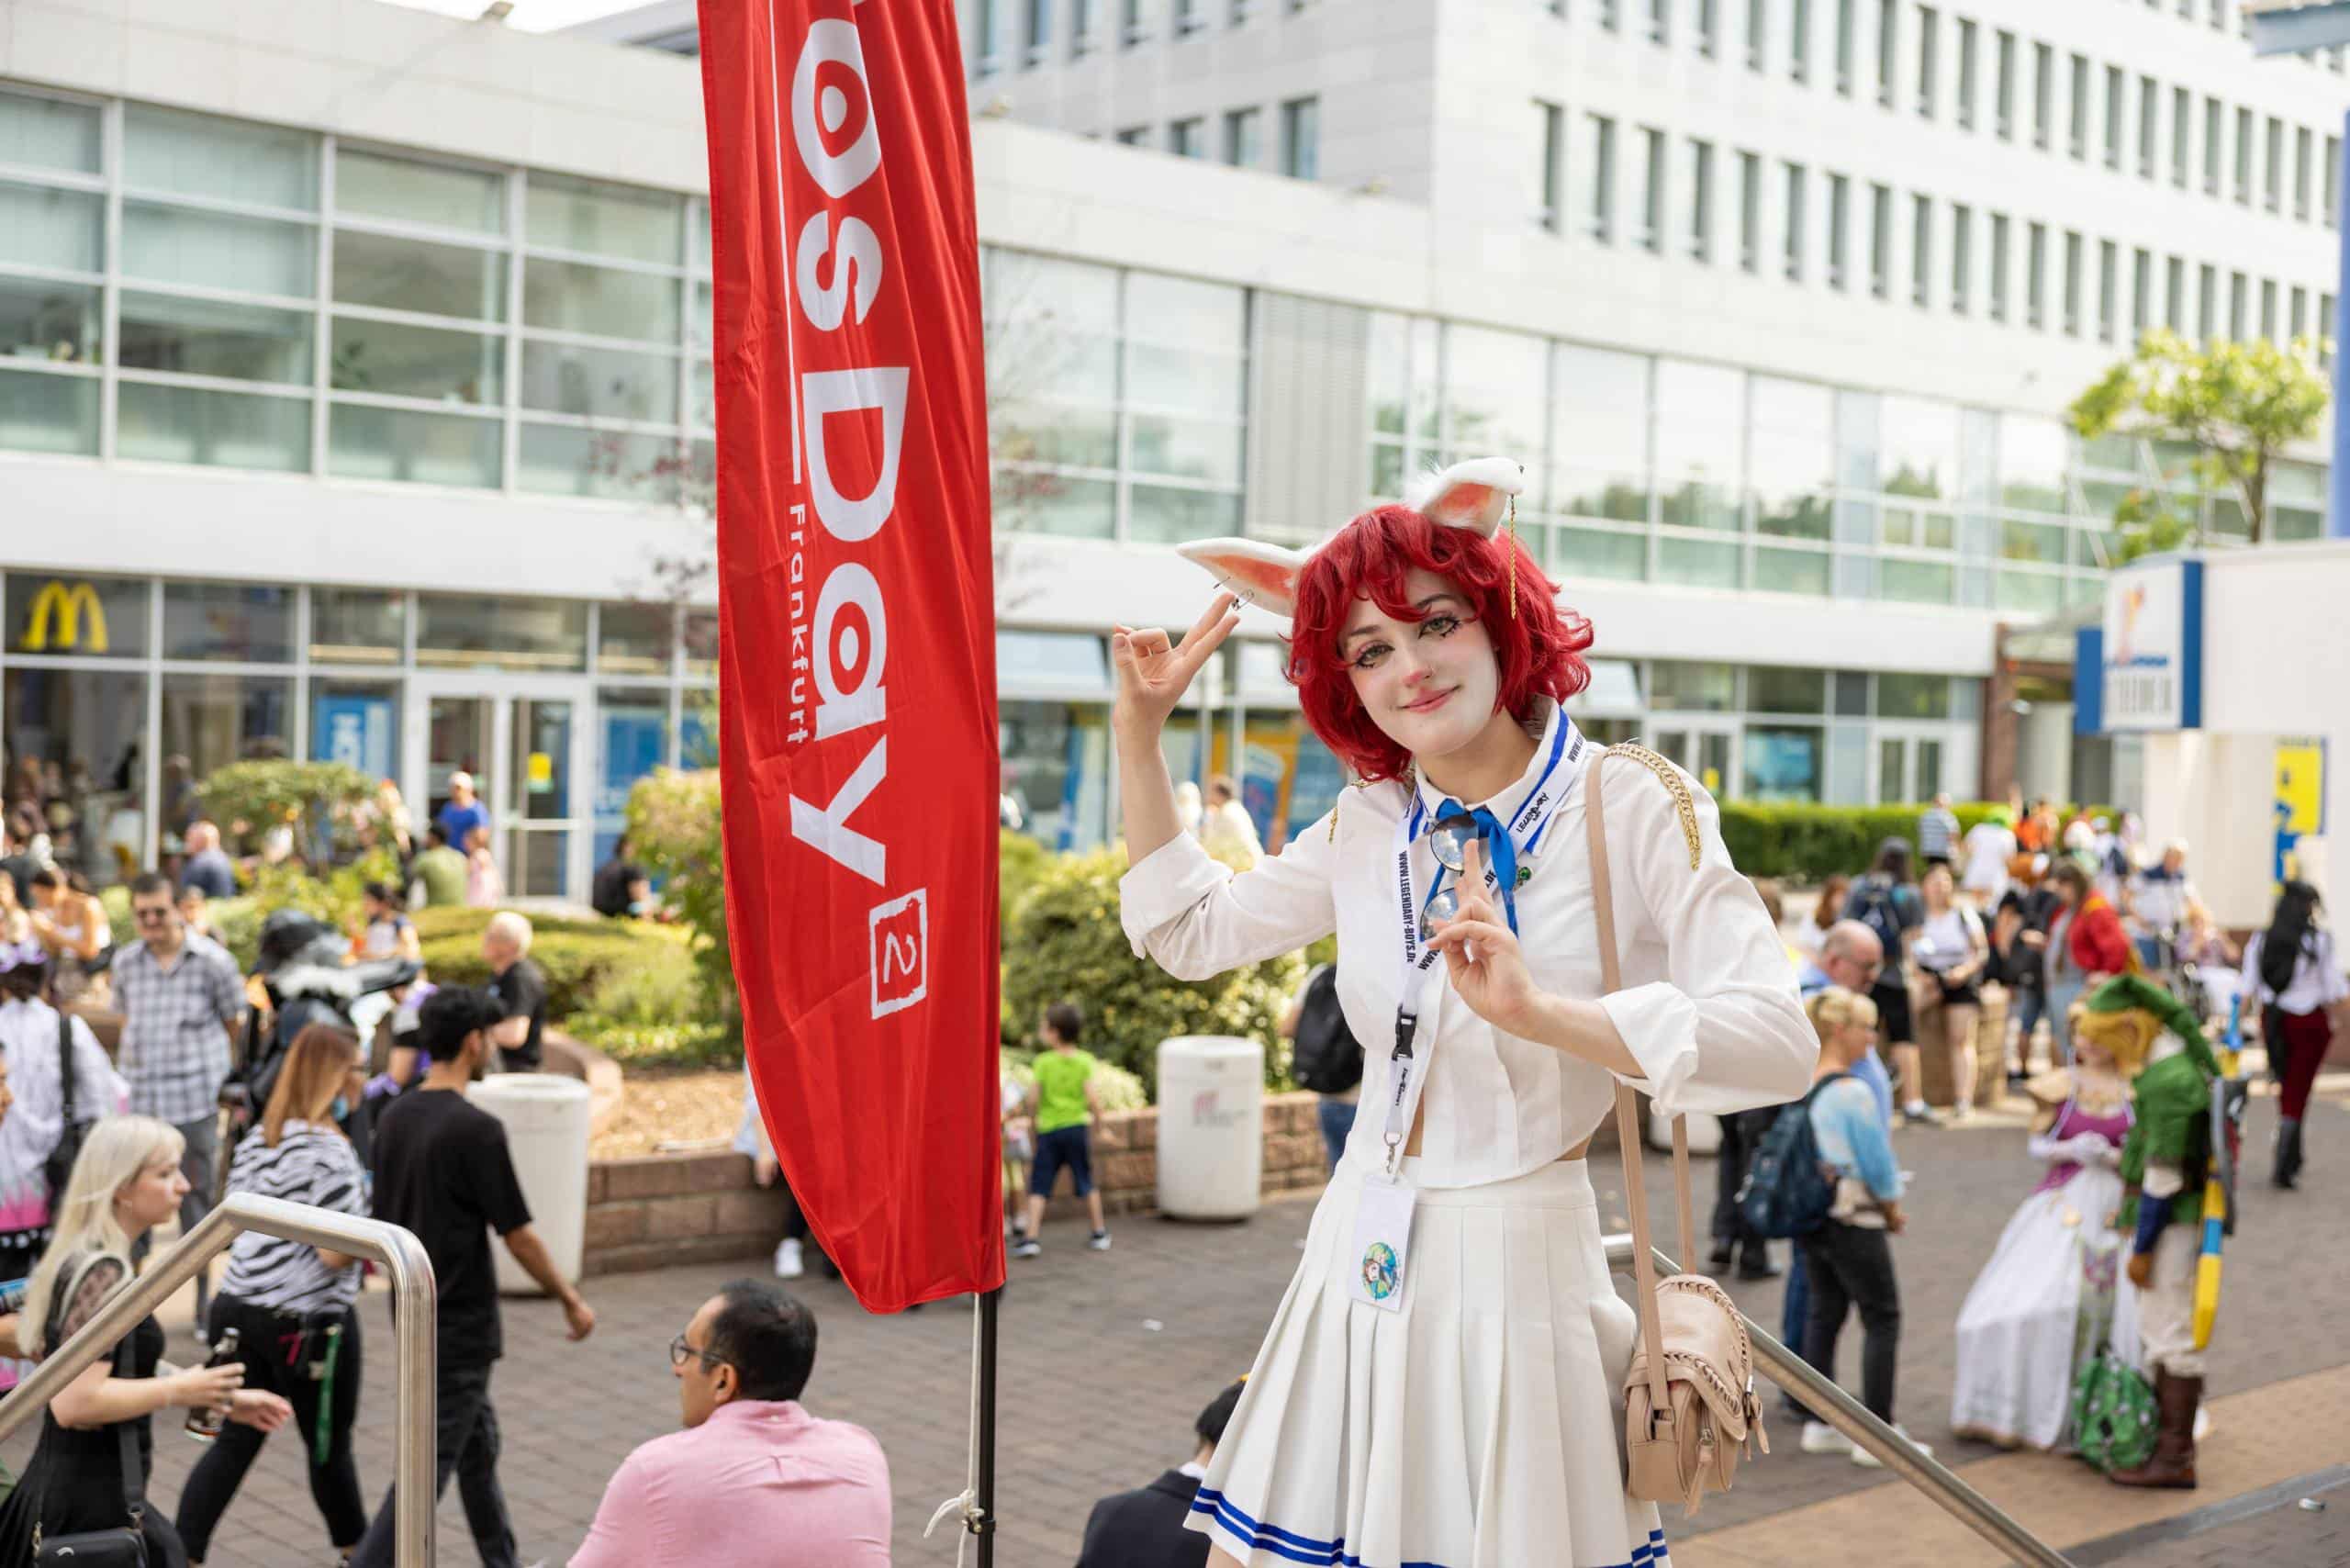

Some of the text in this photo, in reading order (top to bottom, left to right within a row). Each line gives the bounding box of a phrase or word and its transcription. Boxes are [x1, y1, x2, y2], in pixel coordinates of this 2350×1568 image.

[789, 0, 911, 888] osDay
[787, 503, 809, 744] Frankfurt
[883, 932, 917, 984] 2
